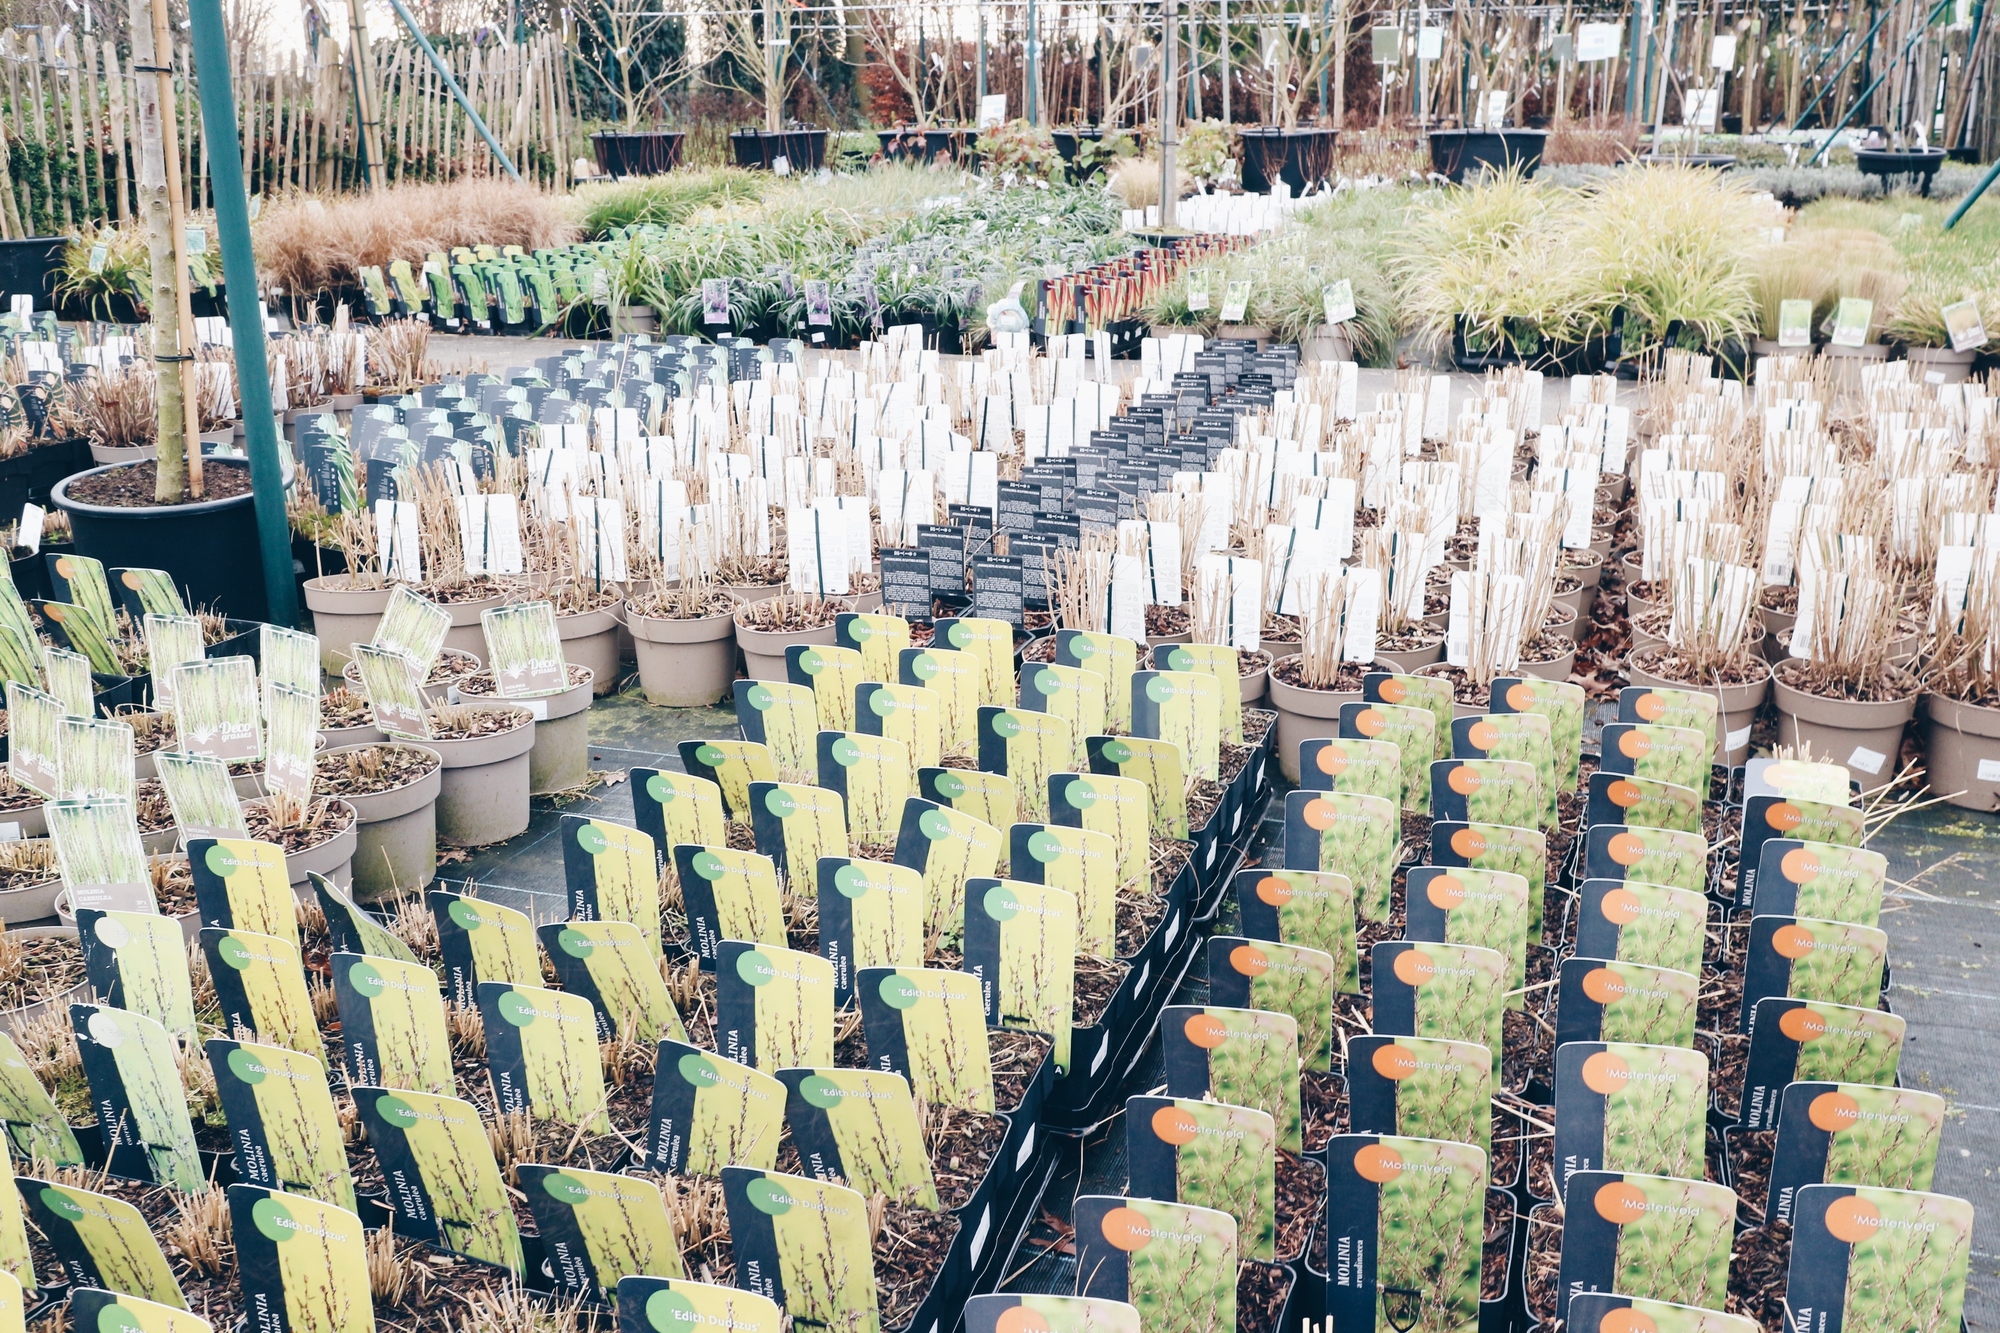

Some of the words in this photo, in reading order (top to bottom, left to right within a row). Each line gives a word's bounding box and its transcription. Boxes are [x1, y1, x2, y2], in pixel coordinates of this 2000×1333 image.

[529, 658, 554, 669] Deco
[531, 667, 556, 677] grasses
[219, 721, 250, 734] Deco
[222, 732, 251, 742] grasses
[1321, 811, 1373, 822] 'Mostenveld'
[1784, 814, 1841, 827] 'Mostenveld'
[935, 822, 956, 836] 'Edith
[592, 836, 611, 846] 'Edith
[1469, 840, 1524, 852] 'Mostenveld'
[1044, 844, 1067, 854] 'Edith
[1627, 846, 1684, 858] 'Mostenveld'
[220, 857, 243, 867] 'Edith
[708, 863, 730, 873] 'Edith
[1801, 863, 1861, 878] 'Mostenveld'
[851, 878, 873, 888] 'Edith
[1742, 869, 1755, 906] MOLINIA
[1275, 888, 1331, 898] 'Mostenveld'
[1447, 889, 1505, 900] 'Mostenveld'
[1001, 900, 1025, 911] 'Edith
[1622, 902, 1683, 918] 'Mostenveld'
[463, 912, 486, 924] 'Edith
[574, 939, 598, 948] 'Edith
[696, 917, 710, 959] MOLINIA
[1794, 938, 1860, 953] 'Mostenveld'
[234, 950, 256, 960] 'Edith
[755, 964, 780, 977] 'Edith
[1250, 958, 1310, 974] 'Mostenveld'
[1414, 964, 1478, 976] 'Mostenveld'
[365, 976, 389, 987] 'Edith
[898, 988, 925, 998] 'Edith
[1604, 982, 1672, 999] 'Mostenveld'
[515, 1005, 541, 1017] 'Edith
[1206, 1027, 1271, 1040] 'Mostenveld'
[1804, 1021, 1875, 1038] 'Mostenveld'
[246, 1063, 271, 1075] 'Edith
[1395, 1058, 1465, 1072] 'Mostenveld'
[698, 1068, 726, 1084] 'Edith
[1606, 1069, 1679, 1083] 'Mostenveld'
[500, 1072, 515, 1112] OLINIA
[820, 1088, 850, 1098] 'Edith
[395, 1108, 423, 1119] 'Edith
[1748, 1085, 1766, 1128] MOLINIA
[1834, 1107, 1913, 1123] 'Mostenveld'
[1175, 1122, 1247, 1139] 'Mostenveld'
[656, 1118, 672, 1163] MOLINIA
[239, 1129, 260, 1181] MOLINIA
[670, 1135, 681, 1170] caerulea
[255, 1146, 269, 1182] caerulea
[1379, 1159, 1456, 1174] 'Mostenveld'
[393, 1170, 417, 1219] MOLINIA
[564, 1185, 595, 1197] 'Edith
[412, 1186, 427, 1221] caerulea
[768, 1192, 800, 1206] 'Edith
[1777, 1187, 1793, 1219] LINIA
[60, 1201, 88, 1214] 'Edith
[1622, 1199, 1703, 1216] 'Mostenveld'
[273, 1215, 303, 1233] 'Edith
[1854, 1214, 1940, 1232] 'Mostenveld'
[1127, 1225, 1206, 1243] 'Mostenveld'
[555, 1242, 578, 1288] MOLINIA
[1337, 1236, 1350, 1287] MOLINIA
[1356, 1239, 1364, 1288] arundinacea
[747, 1260, 762, 1295] LINIA
[255, 1293, 271, 1333] OLINIA
[671, 1309, 706, 1324] 'Edith
